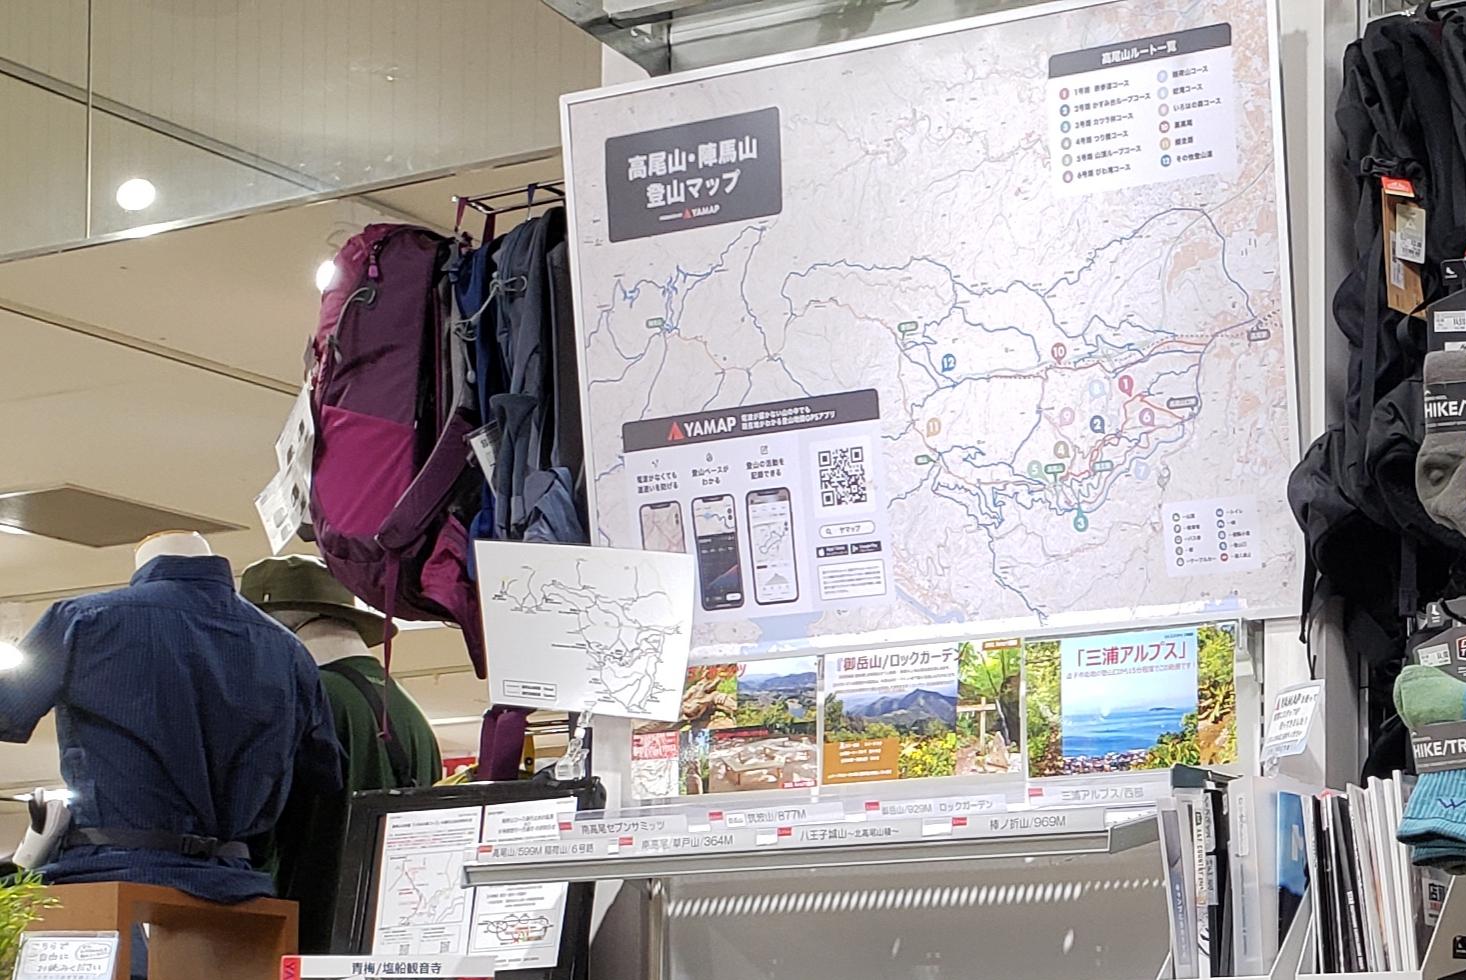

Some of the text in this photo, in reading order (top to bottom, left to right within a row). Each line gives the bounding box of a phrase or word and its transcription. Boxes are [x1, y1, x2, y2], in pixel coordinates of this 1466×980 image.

[646, 168, 741, 208] 登山マップ
[683, 416, 738, 438] YAMAP
[939, 799, 994, 812] ロックガーデン
[746, 808, 807, 825] 筑波山/877M
[492, 844, 543, 859] 高尾山/599M
[351, 961, 442, 976] 青梅/塩船観音寺
